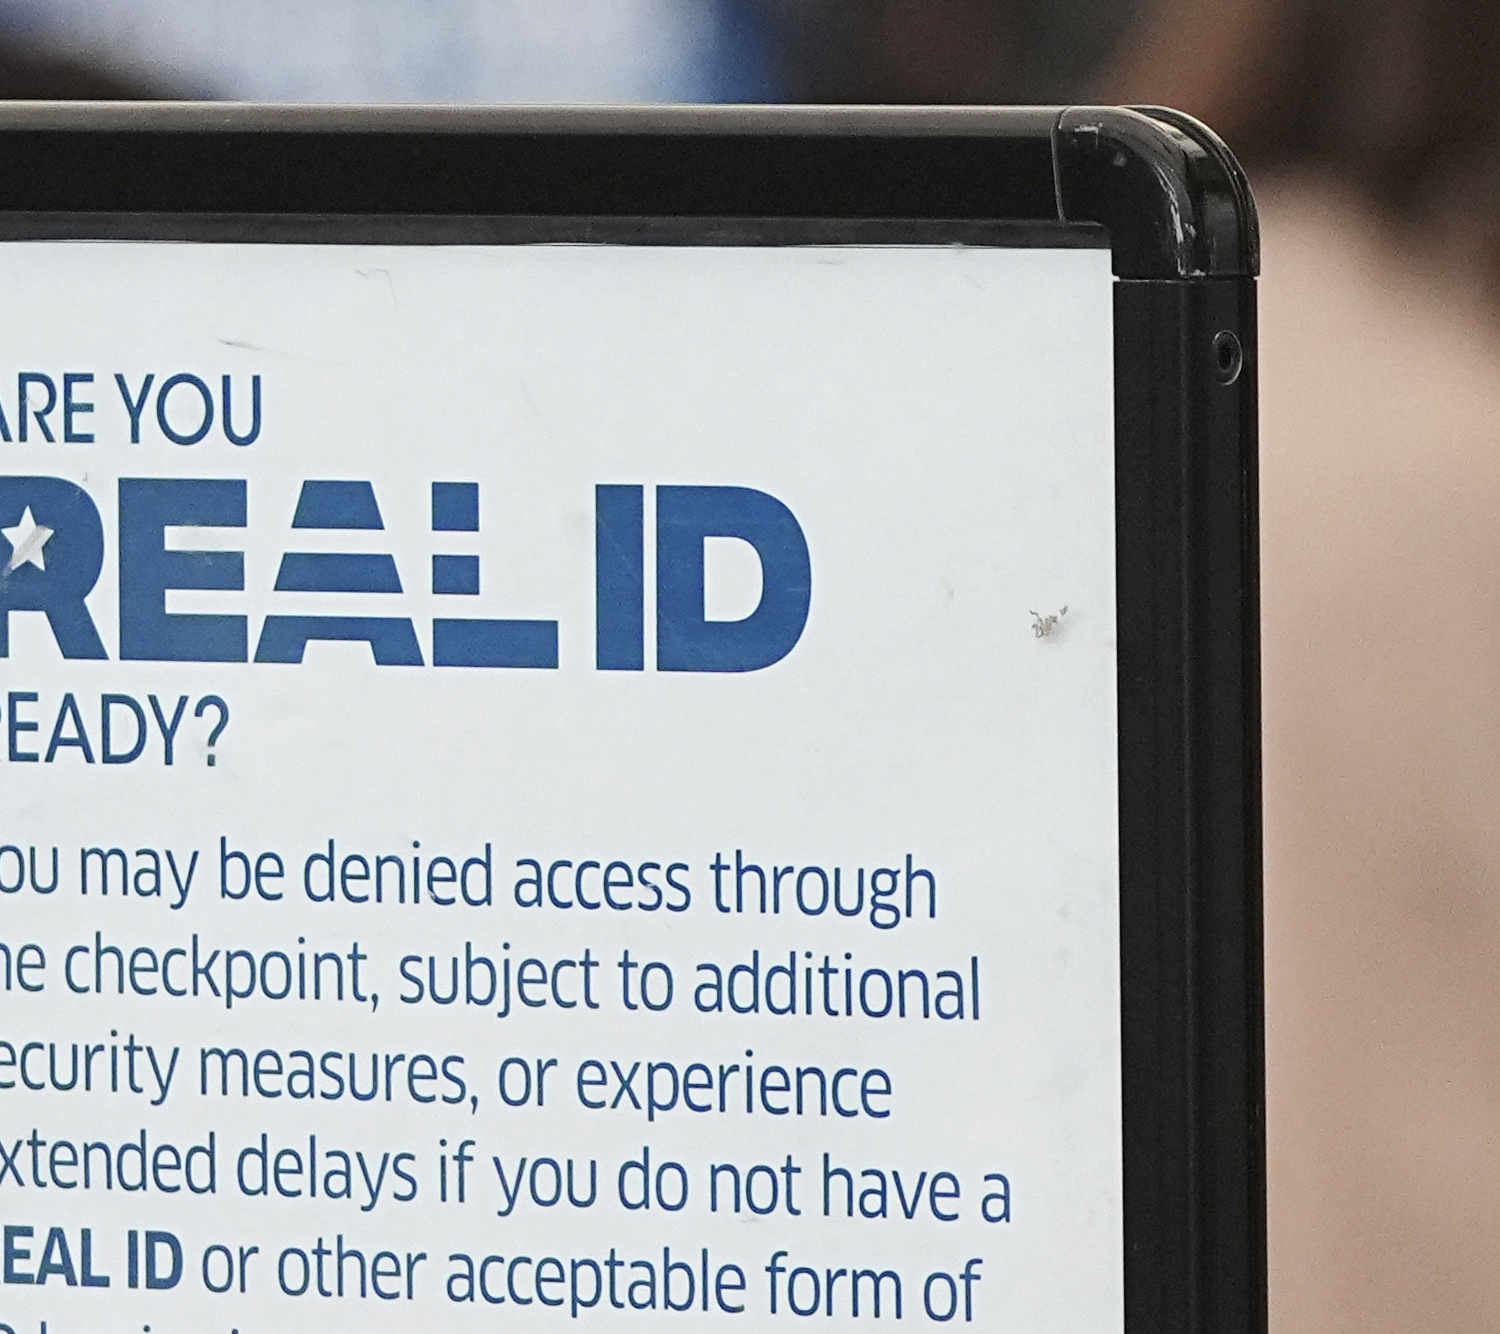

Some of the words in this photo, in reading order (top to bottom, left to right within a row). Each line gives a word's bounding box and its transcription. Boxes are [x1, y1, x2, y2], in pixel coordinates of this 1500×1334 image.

[113, 372, 262, 447] YOU
[594, 483, 812, 674] ID
[80, 847, 200, 911] may
[220, 835, 285, 902] be
[303, 839, 492, 907] denied
[514, 858, 692, 913] access
[709, 848, 936, 930] through
[64, 930, 379, 1013] checkpoint,
[399, 940, 600, 1019] subject
[617, 949, 674, 1012] to
[694, 949, 980, 1021] additional
[200, 1047, 479, 1115] measures,
[498, 1057, 558, 1107] or
[576, 1048, 892, 1123] experience
[236, 1132, 418, 1213] delays
[439, 1138, 476, 1204] if
[492, 1156, 597, 1218] you
[617, 1145, 689, 1212] do
[710, 1154, 802, 1216] not
[823, 1152, 961, 1222] have
[981, 1173, 1011, 1224] a
[127, 1229, 184, 1290] ID
[201, 1244, 260, 1294] or
[277, 1233, 428, 1301] other
[446, 1246, 747, 1319] acceptable
[764, 1250, 903, 1320] form
[923, 1257, 984, 1323] of
